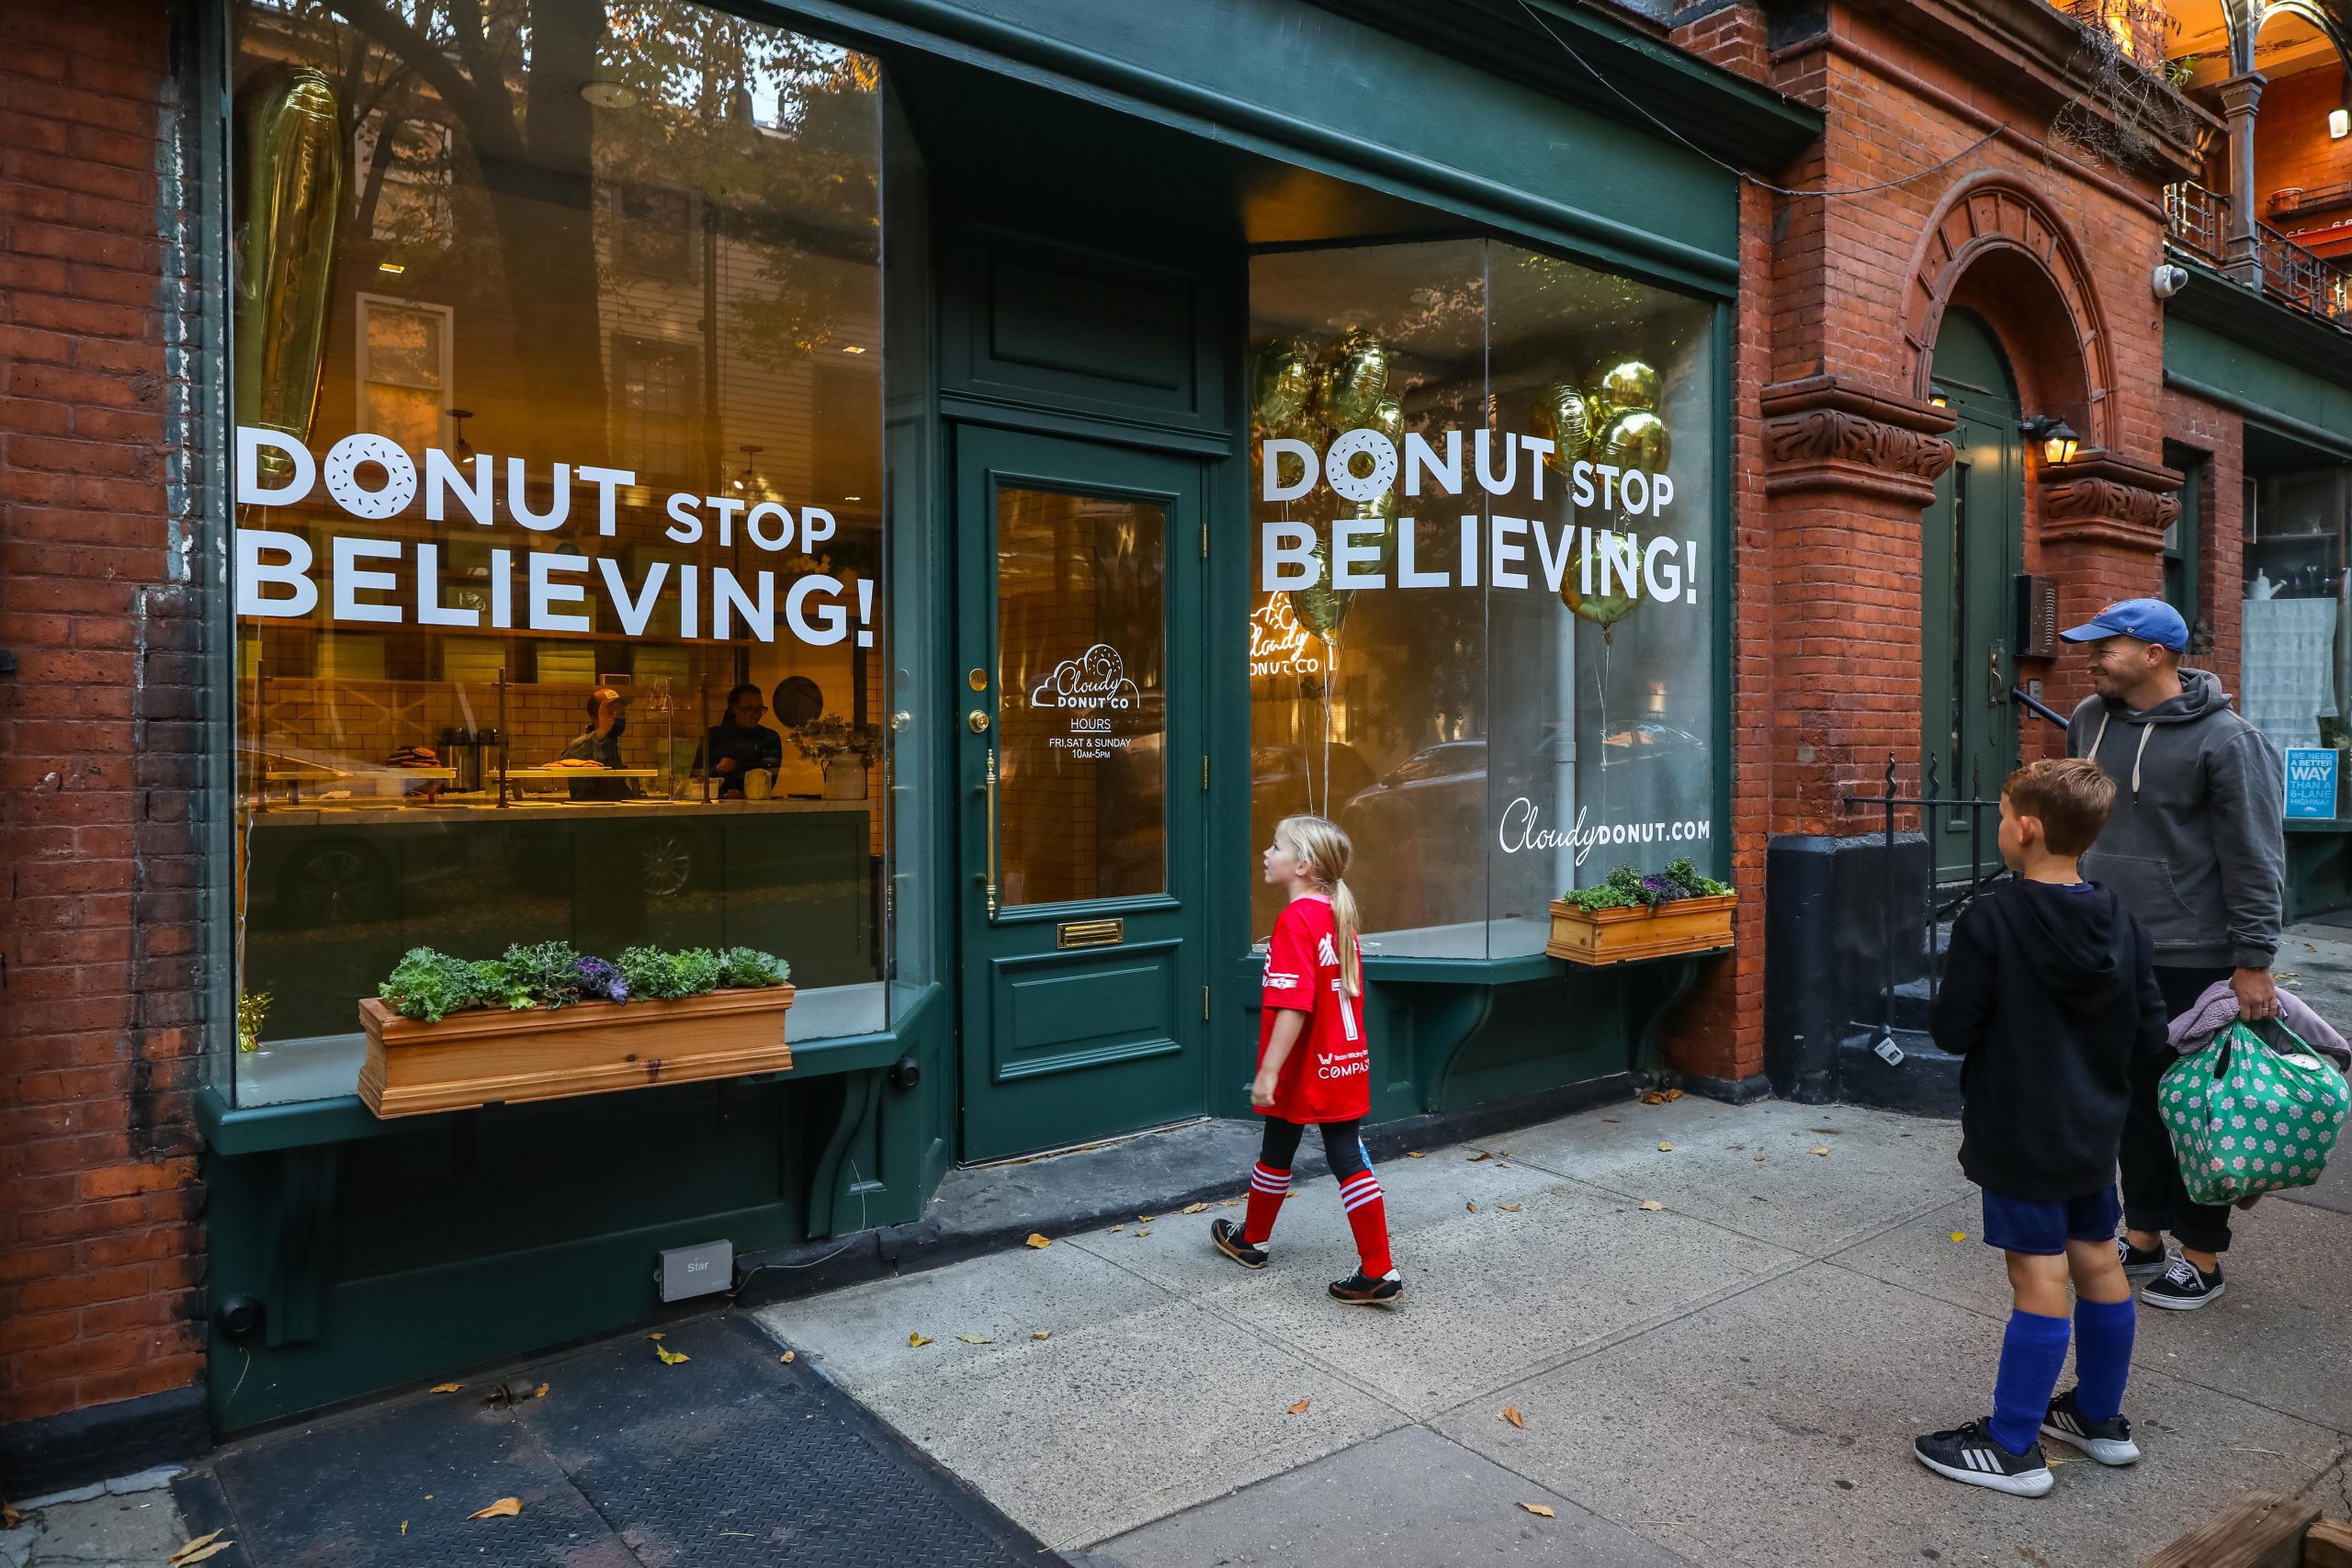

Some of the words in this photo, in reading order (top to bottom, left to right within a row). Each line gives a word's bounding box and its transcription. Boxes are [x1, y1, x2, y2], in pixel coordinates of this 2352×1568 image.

[1262, 428, 1555, 502] DONUT
[1572, 460, 1674, 517] STOP
[237, 426, 636, 536] DONUT
[665, 493, 836, 554] STOP
[1262, 515, 1697, 604] BELIEVING!
[236, 528, 874, 648] BELIEVING!
[1295, 658, 1318, 673] CO
[1057, 666, 1119, 700] Cloudy
[1057, 696, 1106, 708] DONUT
[1111, 697, 1129, 709] CO
[1070, 718, 1111, 729] HOURS
[1049, 738, 1084, 749] FRI,SAT
[1086, 739, 1092, 748] &
[1095, 739, 1131, 748] SUNDAY
[1072, 749, 1111, 759] 10AM-5PM
[2290, 766, 2332, 781] WAY
[2290, 781, 2321, 789] THAN
[2324, 781, 2332, 789] A
[2290, 790, 2332, 798] 6-LANE
[687, 1261, 709, 1272] Star
